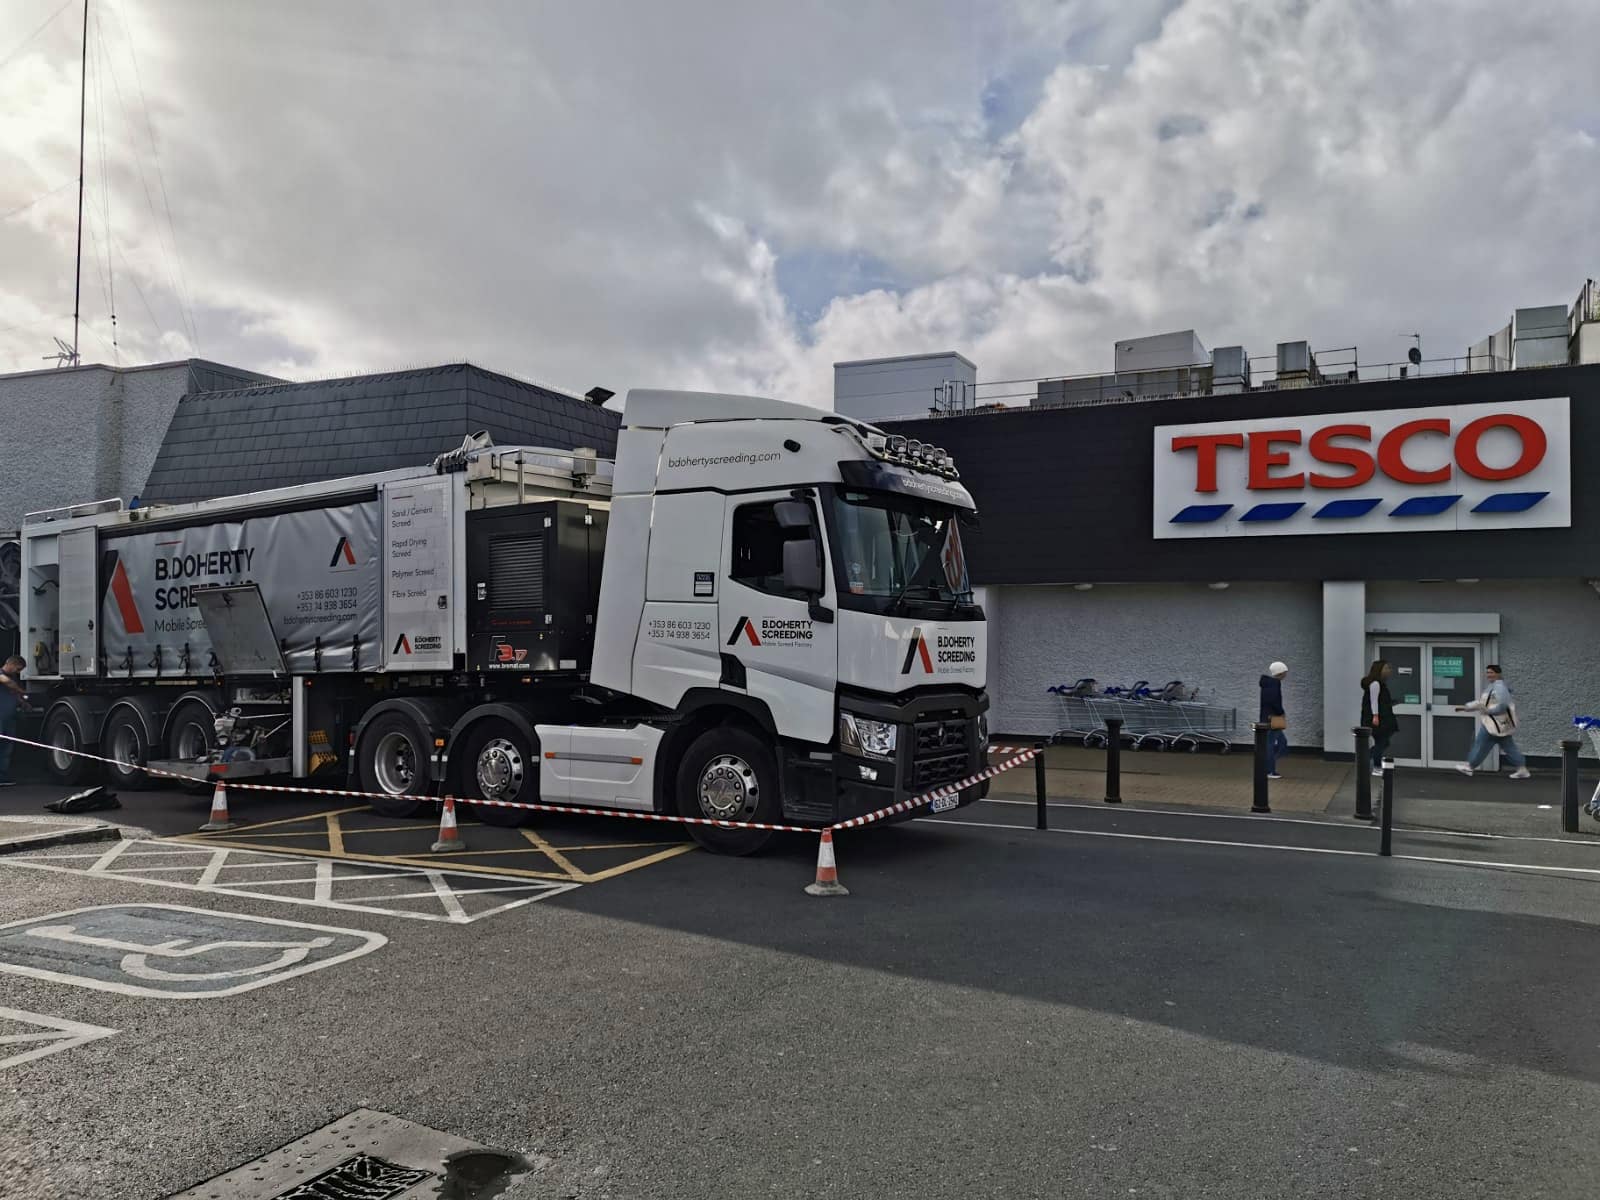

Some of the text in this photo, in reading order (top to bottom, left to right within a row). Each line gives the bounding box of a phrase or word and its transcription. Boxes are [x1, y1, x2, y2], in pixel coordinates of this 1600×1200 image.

[1171, 413, 1547, 493] TESCO
[668, 452, 781, 468] bdohertyscreeding.com
[391, 520, 412, 528] Screed
[391, 538, 427, 548] Rapid Drying
[391, 550, 412, 558] Screed
[155, 547, 255, 581] B.DOHERTY
[391, 568, 435, 580] Polymer Screed
[297, 586, 358, 601] +353 86 603 1230
[407, 589, 427, 597] Screed
[296, 602, 313, 612] +353
[323, 600, 338, 610] 938
[338, 599, 357, 610] 3654
[154, 616, 185, 633] Mobile
[648, 620, 711, 630] +353 86 603 1230
[761, 620, 814, 629] B.DOHERTY
[647, 629, 711, 640] +353 74 938 3654
[761, 630, 814, 640] SCREEDING
[937, 635, 975, 648] B.DOHERTY
[937, 650, 976, 663] SCREEDING
